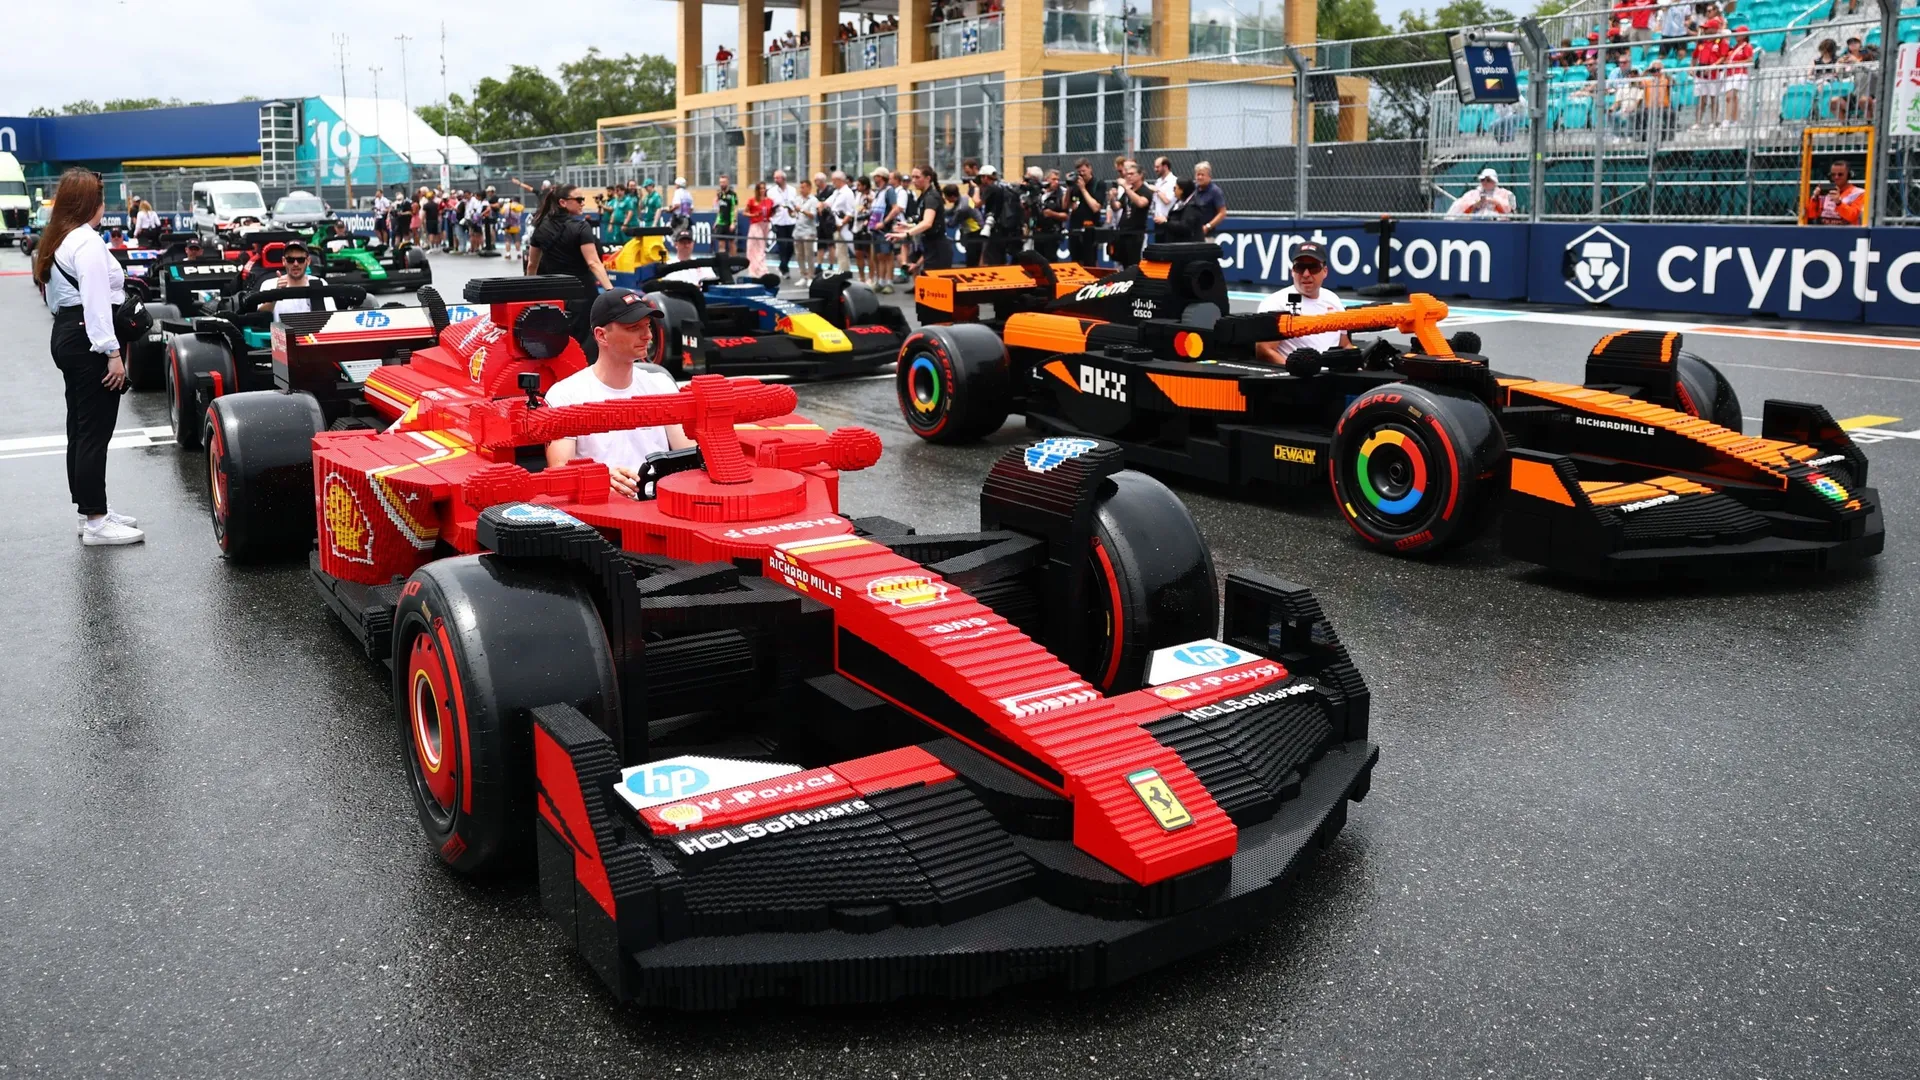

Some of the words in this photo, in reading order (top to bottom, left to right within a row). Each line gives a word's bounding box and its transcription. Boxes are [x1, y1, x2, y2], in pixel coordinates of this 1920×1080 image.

[1475, 66, 1508, 75] crypto.com
[310, 120, 360, 178] 19
[1075, 280, 1134, 301] Chrome
[712, 336, 757, 348] Red
[1080, 363, 1127, 403] OKX
[1348, 392, 1403, 420] ZERO
[1273, 444, 1317, 464] DEWALT
[769, 556, 809, 583] RICHARD
[810, 574, 842, 599] MILLE
[998, 682, 1098, 719] PIRELLI
[1183, 683, 1315, 721] HCLSoftware
[643, 765, 696, 798] hp
[678, 799, 870, 856] HCLSoftware
